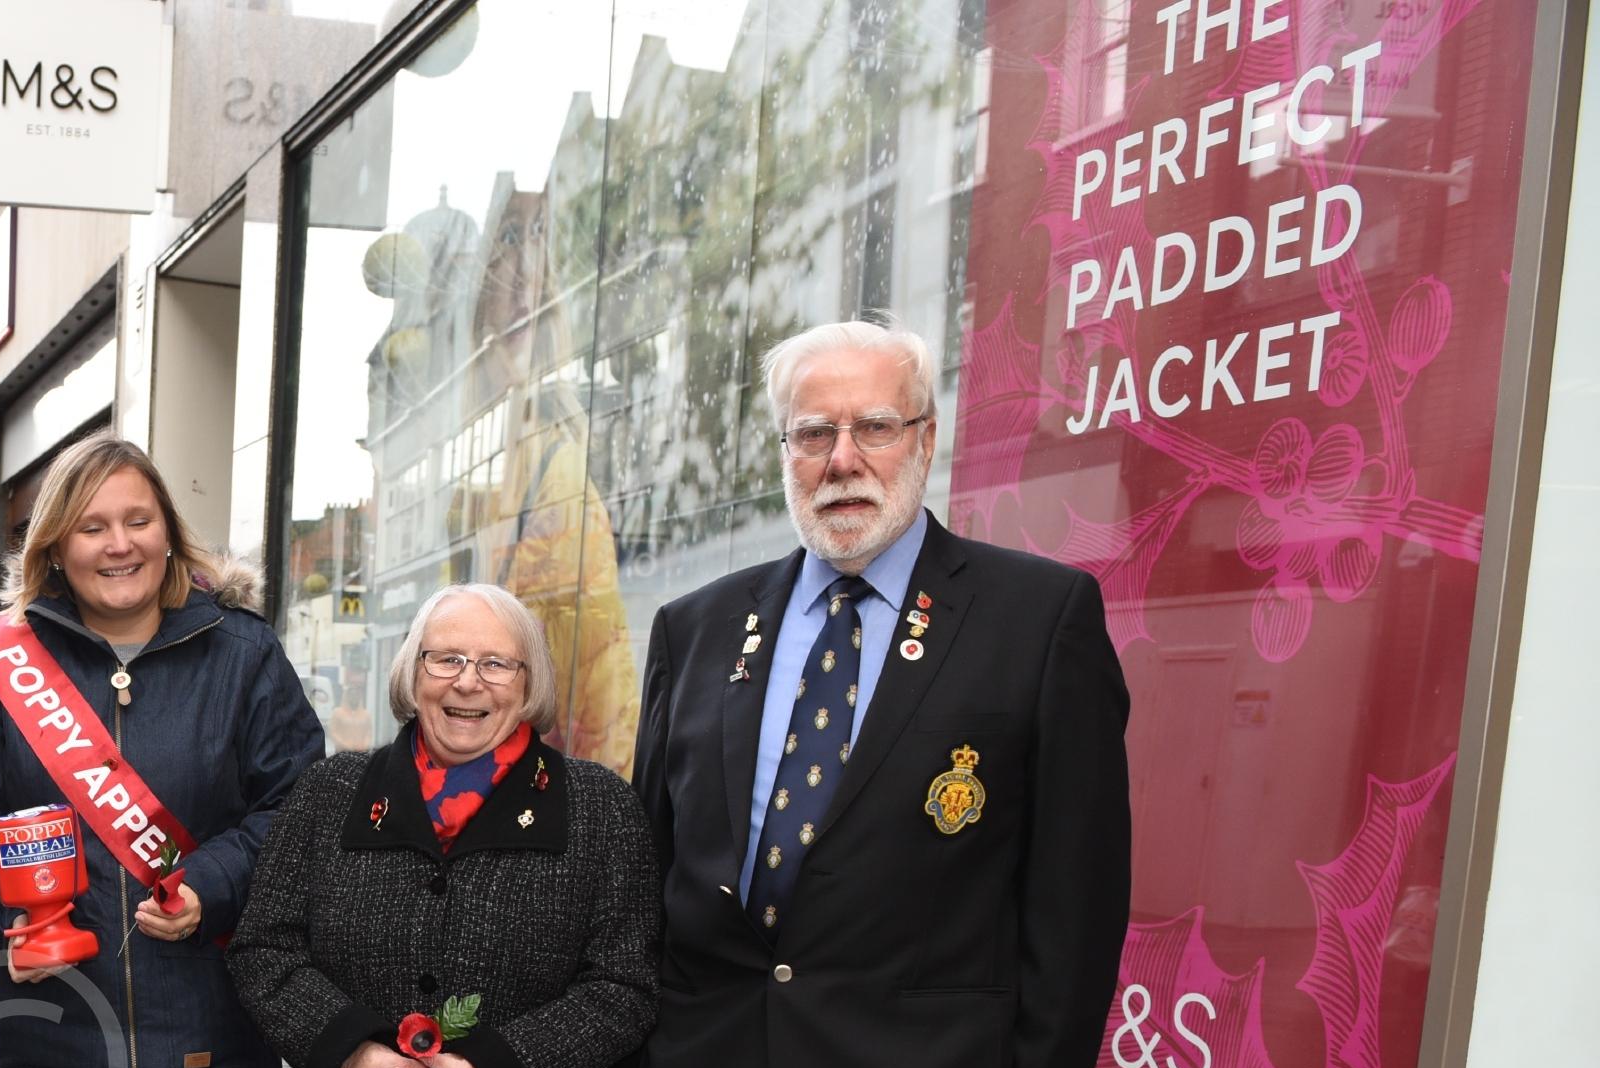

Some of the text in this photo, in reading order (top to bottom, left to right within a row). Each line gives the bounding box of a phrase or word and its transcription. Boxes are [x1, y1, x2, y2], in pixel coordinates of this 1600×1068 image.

[1156, 0, 1290, 75] THE
[2, 58, 118, 113] M&S
[1072, 41, 1382, 221] PERFECT
[1066, 184, 1362, 329] PADDED
[1066, 311, 1341, 435] JACKET
[3, 822, 66, 844] POPPY
[6, 836, 71, 857] APPEAL
